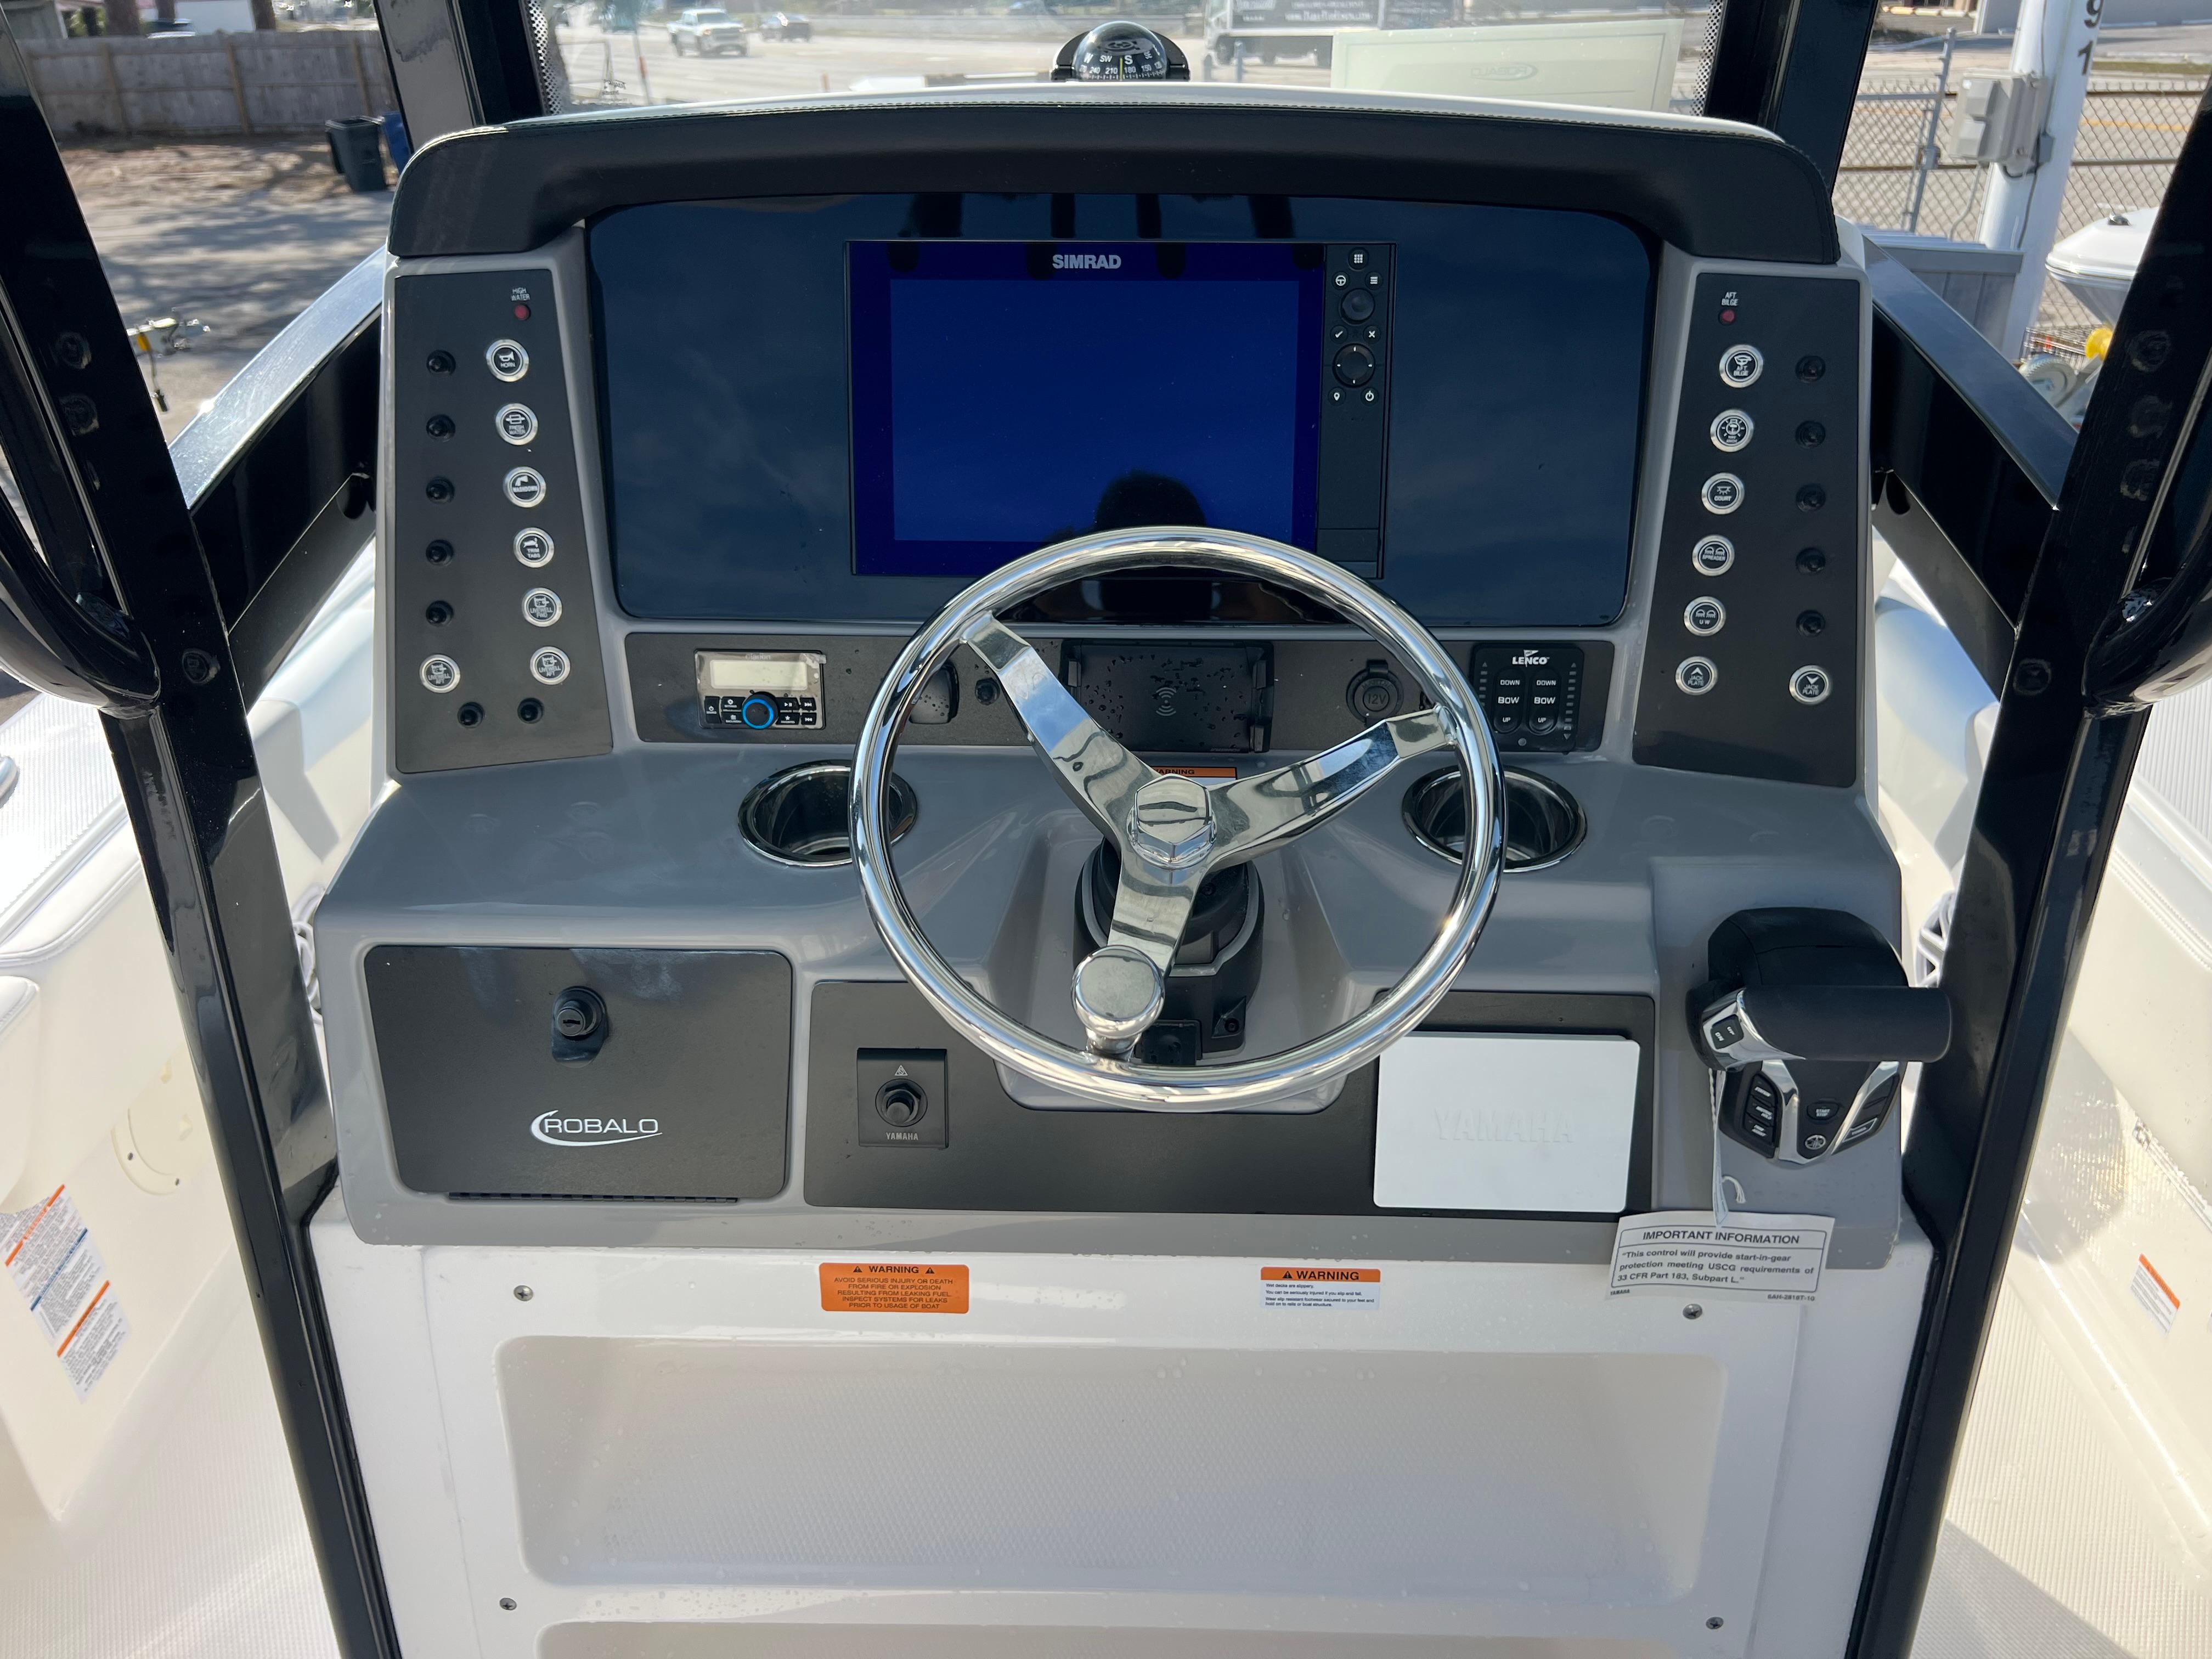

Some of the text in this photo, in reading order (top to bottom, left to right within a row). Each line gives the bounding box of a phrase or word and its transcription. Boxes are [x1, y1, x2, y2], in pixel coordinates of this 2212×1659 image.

[1124, 55, 1133, 65] S
[1052, 255, 1121, 269] SIMRAD
[1367, 693, 1387, 704] 12V
[1727, 1026, 1735, 1035] UP
[1715, 1032, 1724, 1041] DN
[544, 1118, 659, 1133] ROBALO
[1434, 1108, 1575, 1143] YAMAHA
[1643, 1231, 1799, 1244] IMPORTANT INFORMATION
[1698, 1251, 1733, 1261] provide
[1735, 1254, 1791, 1263] start-in-gear
[1620, 1261, 1663, 1272] protection
[1667, 1262, 1704, 1271] meeting
[1708, 1263, 1736, 1271] USCG
[1740, 1265, 1800, 1274] requirements
[1296, 1271, 1359, 1280] WARNING
[1672, 1273, 1689, 1281] 183,
[1692, 1273, 1728, 1283] Subpart
